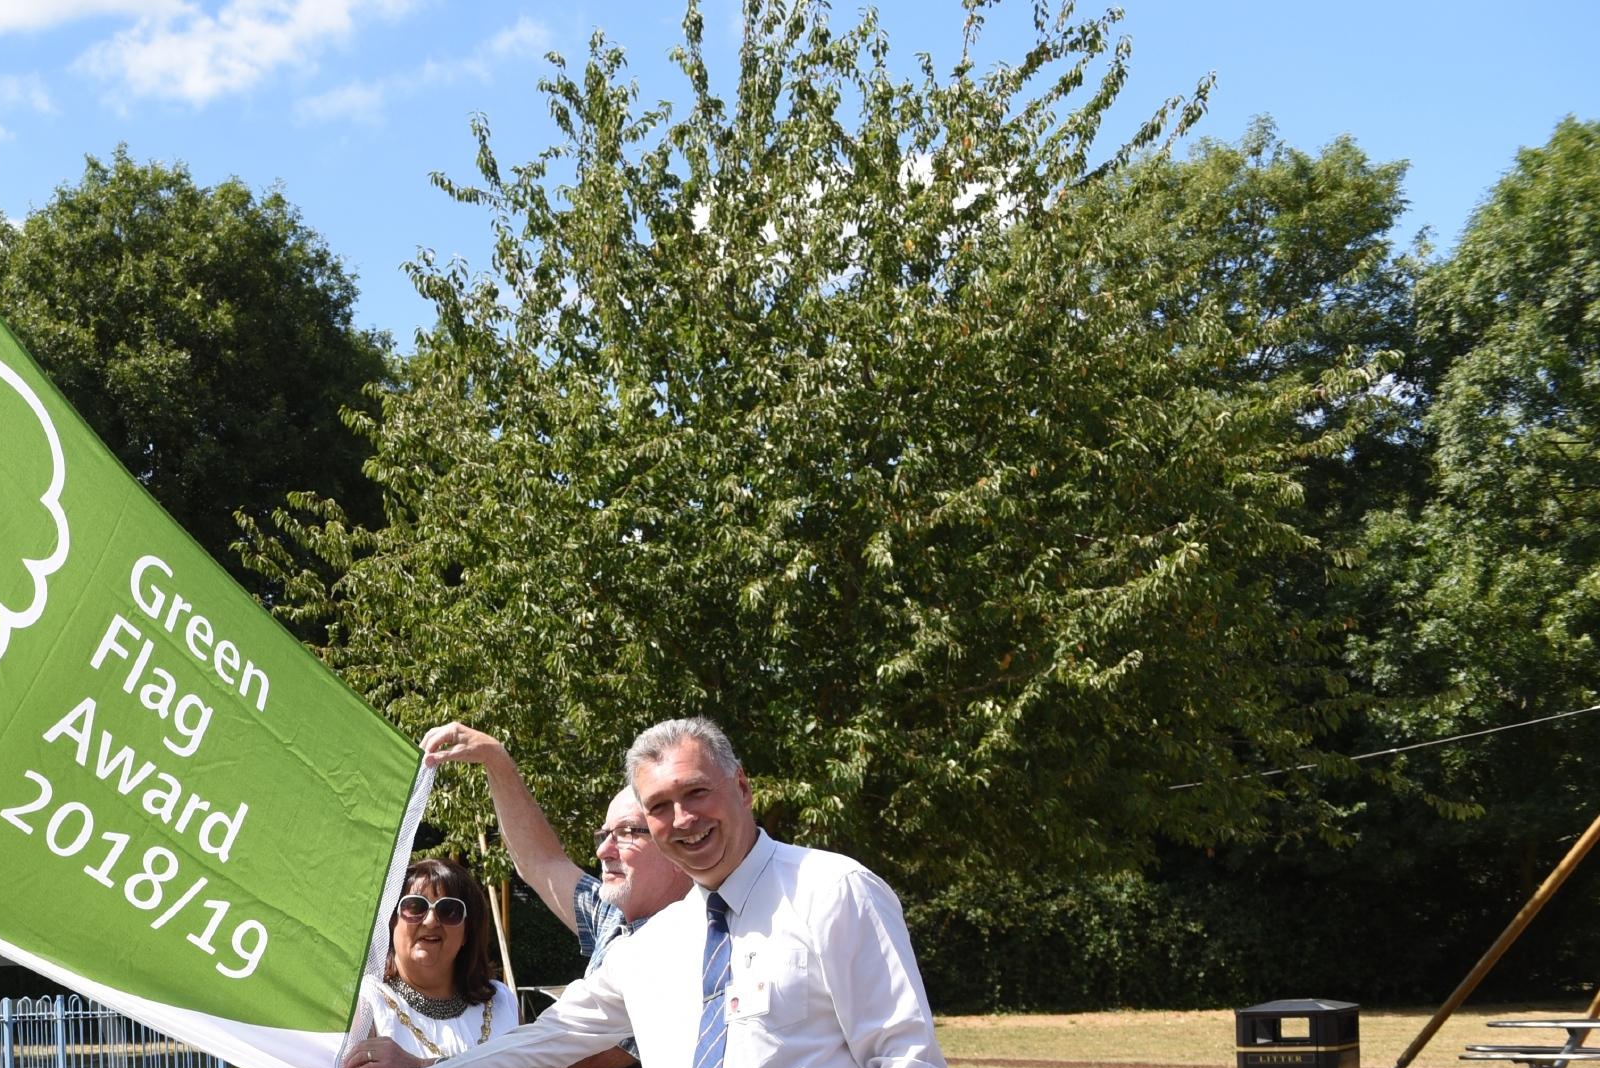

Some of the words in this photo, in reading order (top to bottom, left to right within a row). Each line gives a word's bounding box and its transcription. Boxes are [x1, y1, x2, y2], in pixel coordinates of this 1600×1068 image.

[90, 613, 214, 758] Flag
[130, 555, 270, 712] Green
[42, 696, 249, 864] Award
[0, 769, 269, 980] 2018/19
[1259, 1055, 1303, 1063] LITTER
